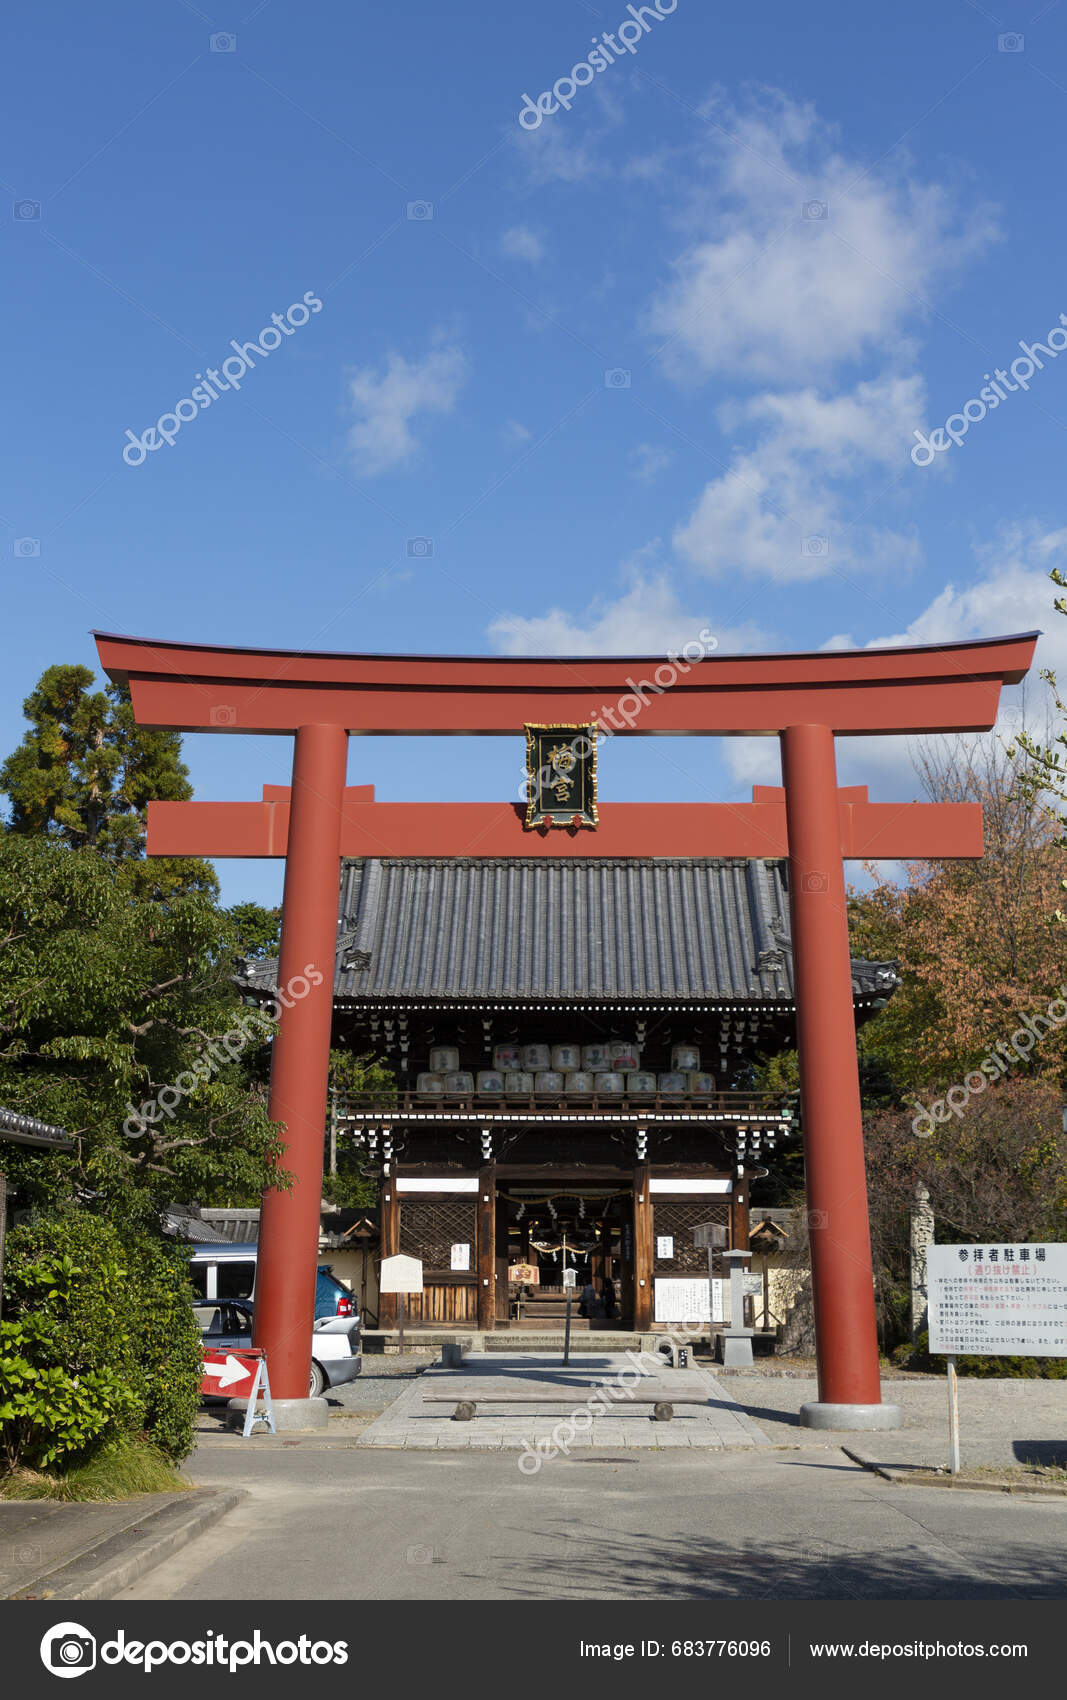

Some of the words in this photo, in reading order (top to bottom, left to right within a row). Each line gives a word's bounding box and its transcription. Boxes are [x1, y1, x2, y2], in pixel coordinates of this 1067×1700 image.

[958, 1248, 1046, 1262] 参拝者駐車場
